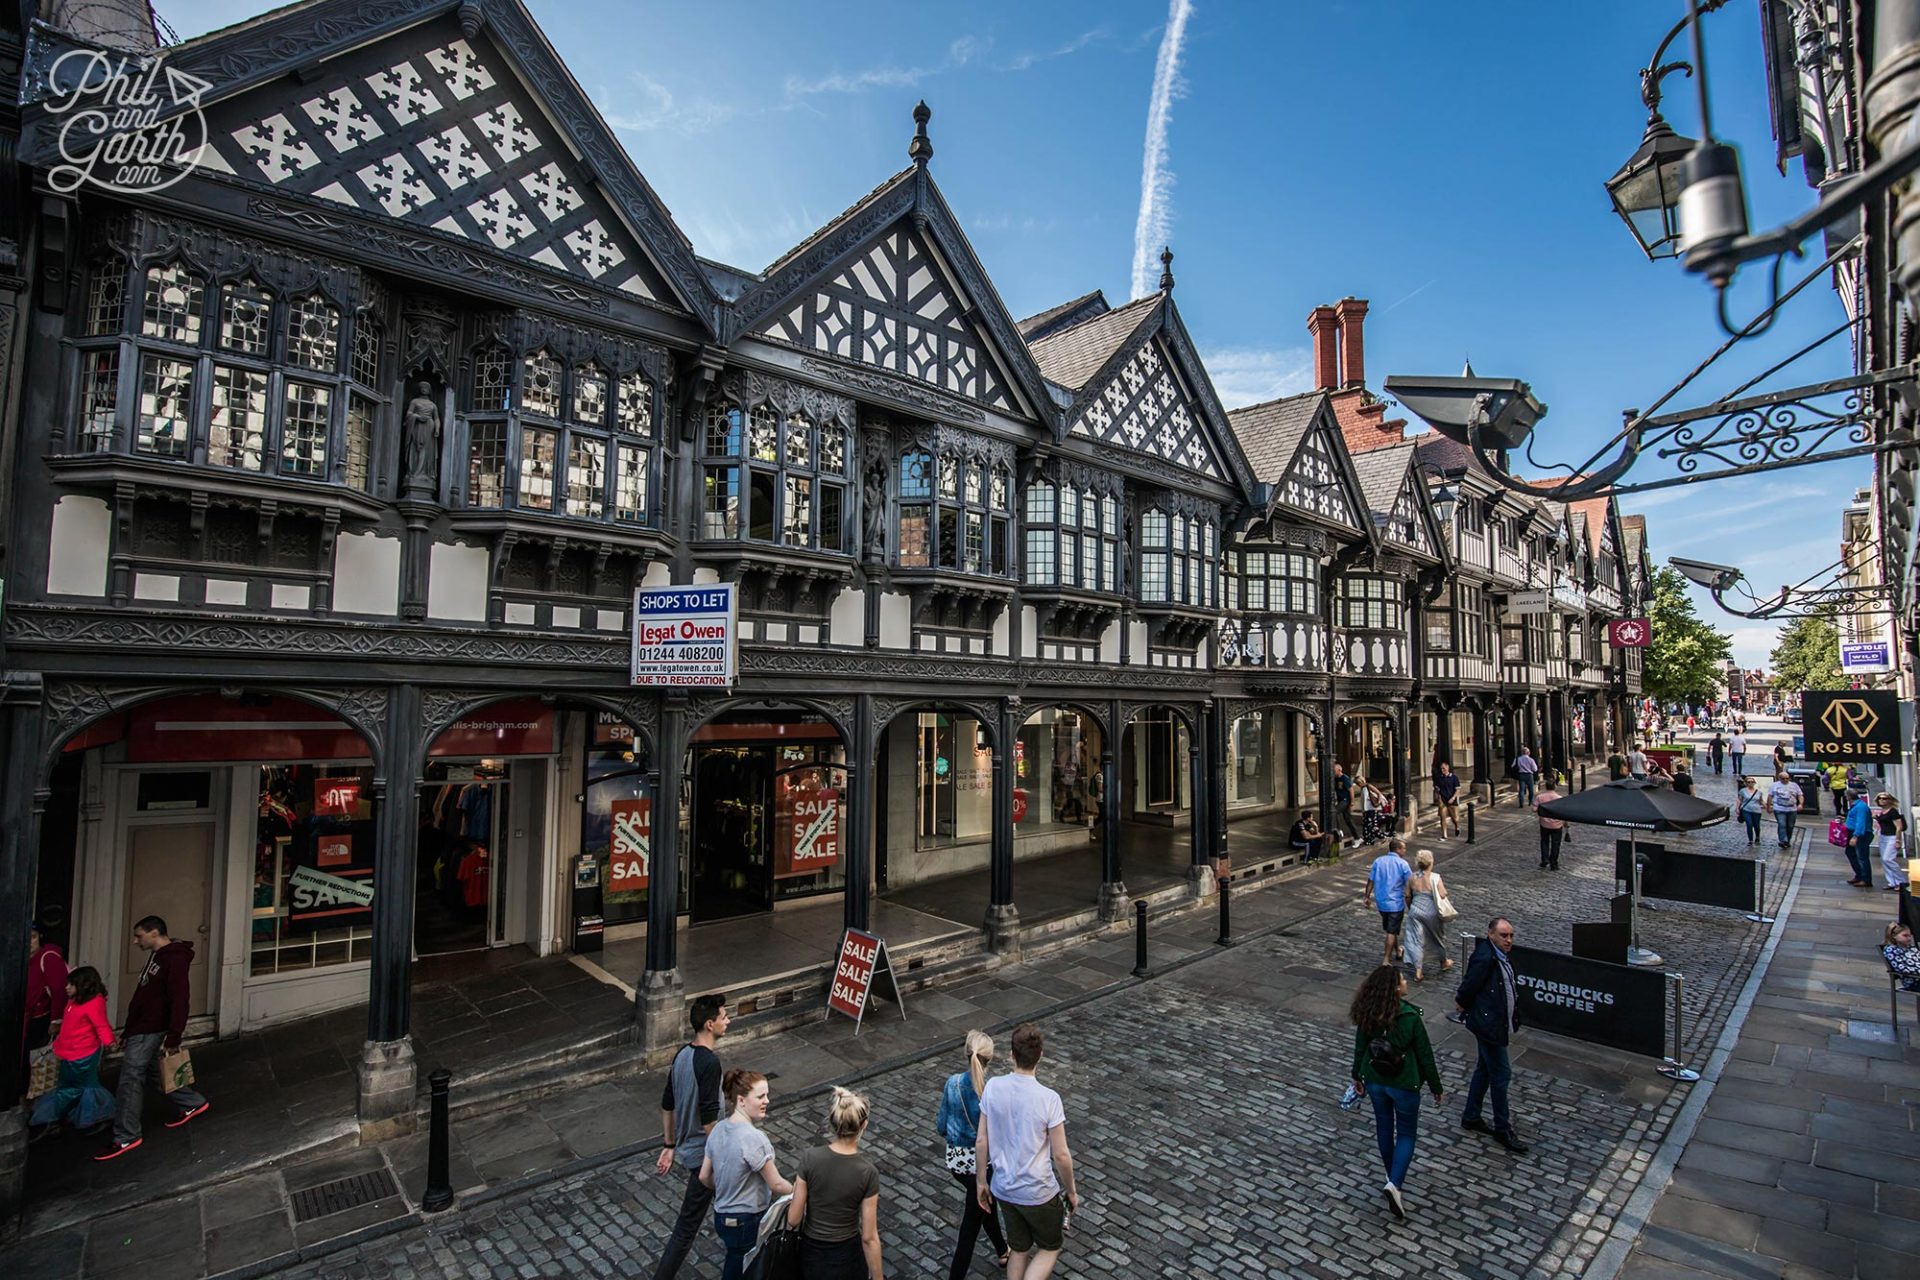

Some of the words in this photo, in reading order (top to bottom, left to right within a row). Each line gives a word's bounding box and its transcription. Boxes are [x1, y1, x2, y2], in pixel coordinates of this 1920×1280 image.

[642, 595, 680, 609] SHOPS
[684, 594, 700, 608] TO
[703, 593, 726, 607] LET
[640, 623, 676, 645] Legat
[680, 621, 724, 639] Owen
[640, 648, 674, 660] 01244
[678, 646, 724, 660] 408200
[640, 664, 724, 673] www.legatowen.co.uk
[636, 676, 652, 684] DUE
[656, 676, 668, 684] TO
[670, 676, 726, 685] RELOCATION
[449, 720, 538, 730] llis-brigham.com
[1812, 742, 1892, 754] ROSIES
[794, 799, 837, 816] SALE
[614, 810, 650, 828] SAL
[794, 820, 837, 838] SE
[794, 841, 836, 860] SALE
[612, 860, 649, 880] SAL
[294, 872, 328, 887] FURTHER
[328, 882, 371, 900] REDUCTIONS
[844, 940, 875, 964] SALE
[839, 962, 870, 986] SALE
[833, 982, 864, 1007] SALE
[1517, 974, 1614, 1005] STARBUCKS
[1534, 990, 1595, 1013] COFFEE
